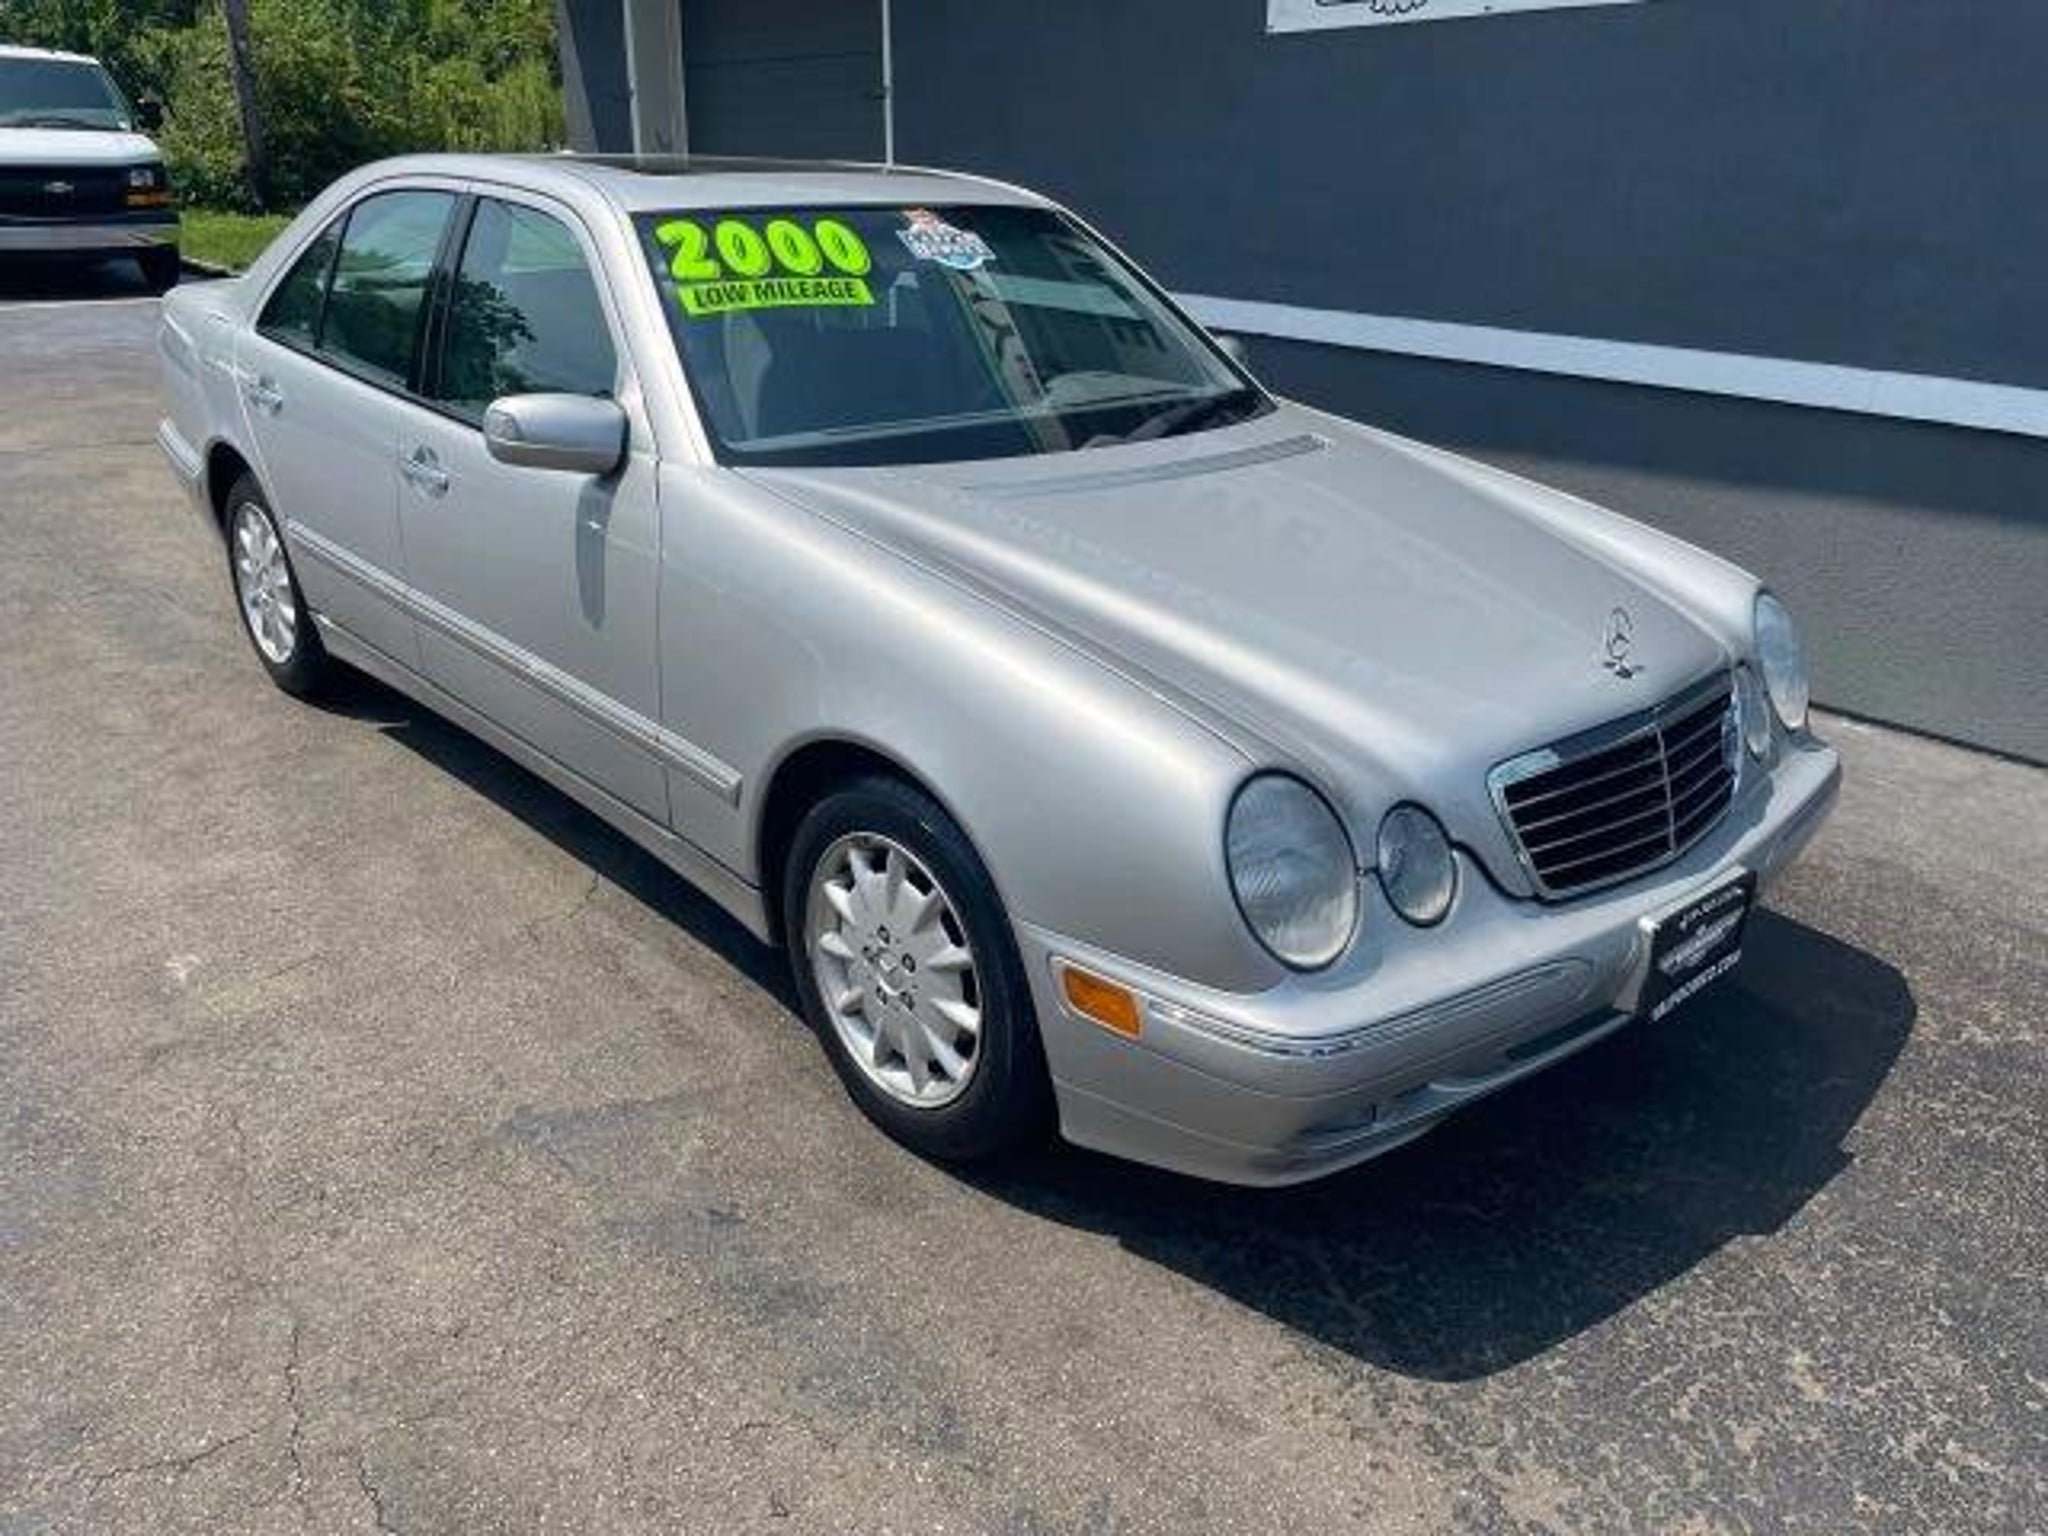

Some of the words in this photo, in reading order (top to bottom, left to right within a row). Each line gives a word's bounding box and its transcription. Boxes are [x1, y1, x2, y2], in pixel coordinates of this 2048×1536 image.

[655, 219, 871, 279] 2000
[692, 282, 747, 308] LOW
[753, 279, 859, 302] MILEAGE
